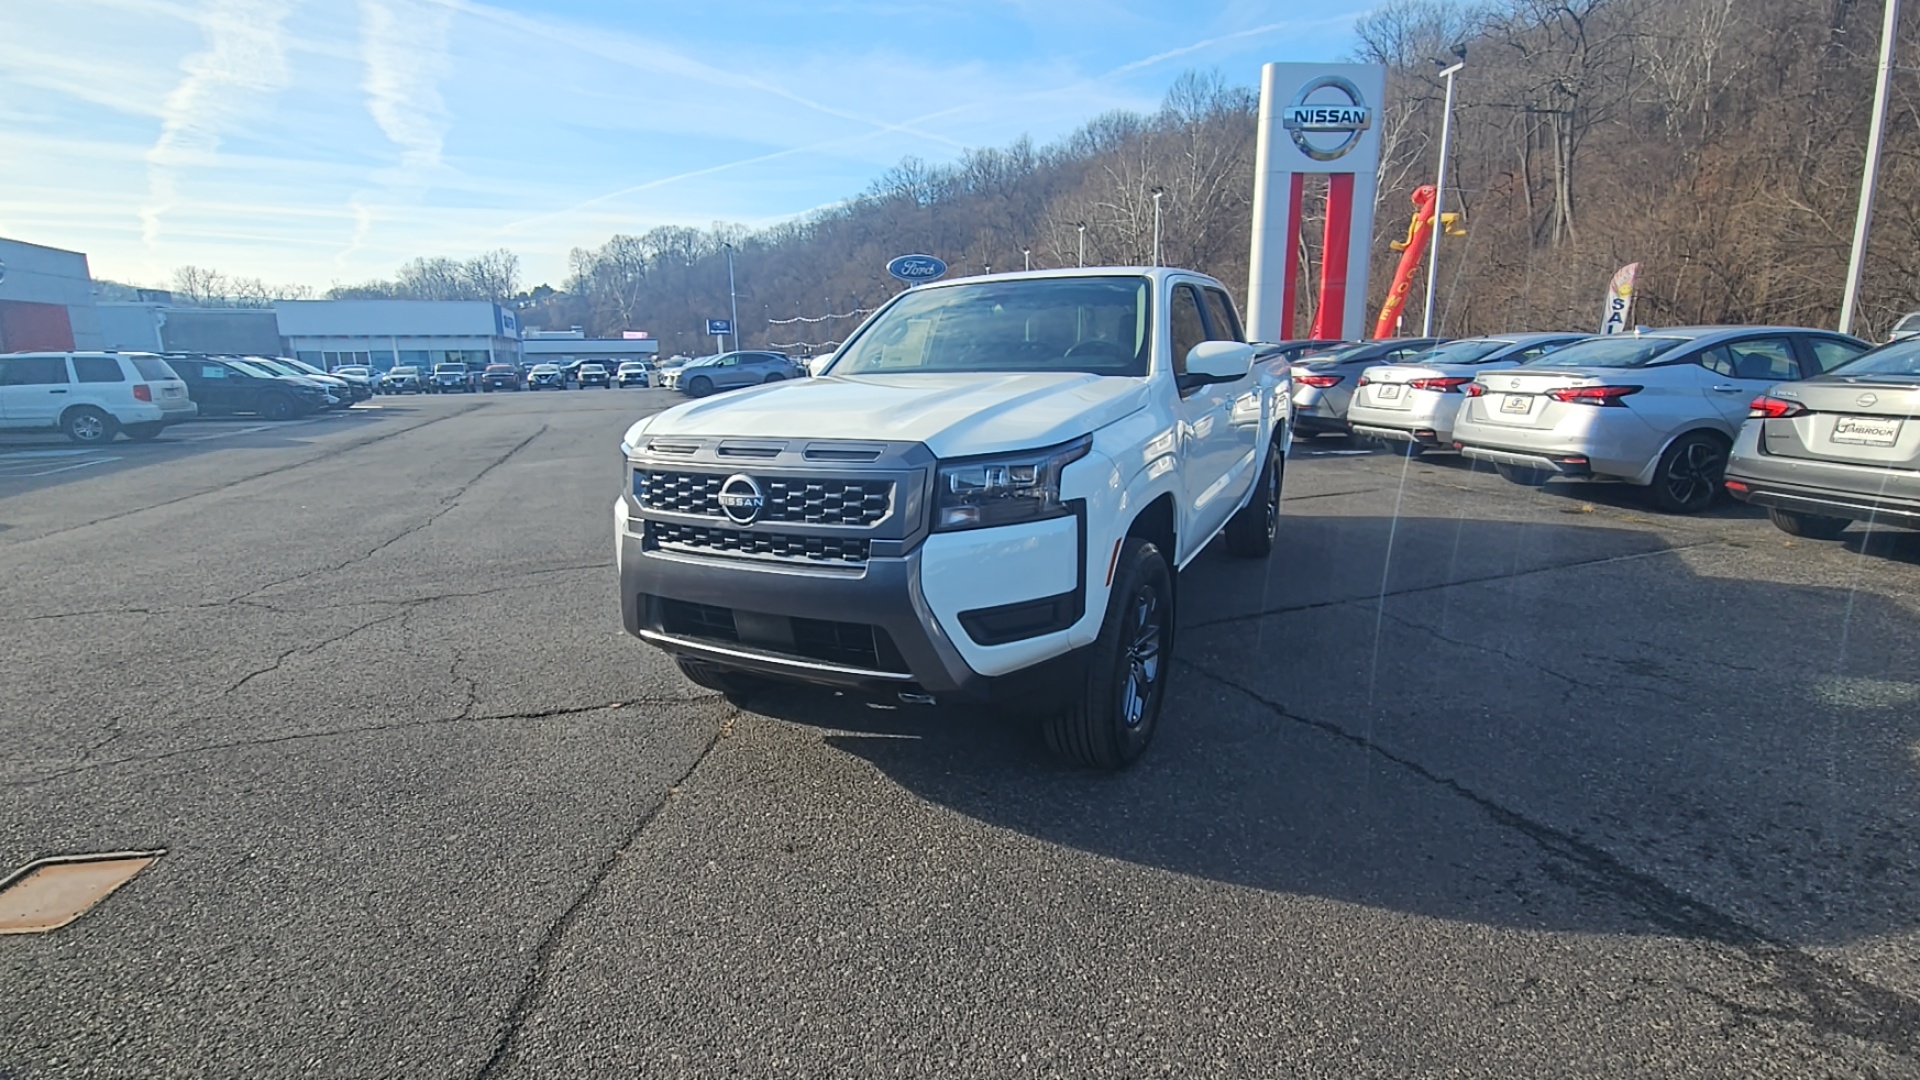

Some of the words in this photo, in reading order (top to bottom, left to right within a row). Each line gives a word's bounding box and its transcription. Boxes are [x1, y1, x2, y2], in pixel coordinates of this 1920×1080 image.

[1294, 109, 1365, 124] NISSAN
[901, 260, 936, 276] Ford
[720, 496, 764, 507] NISSAN
